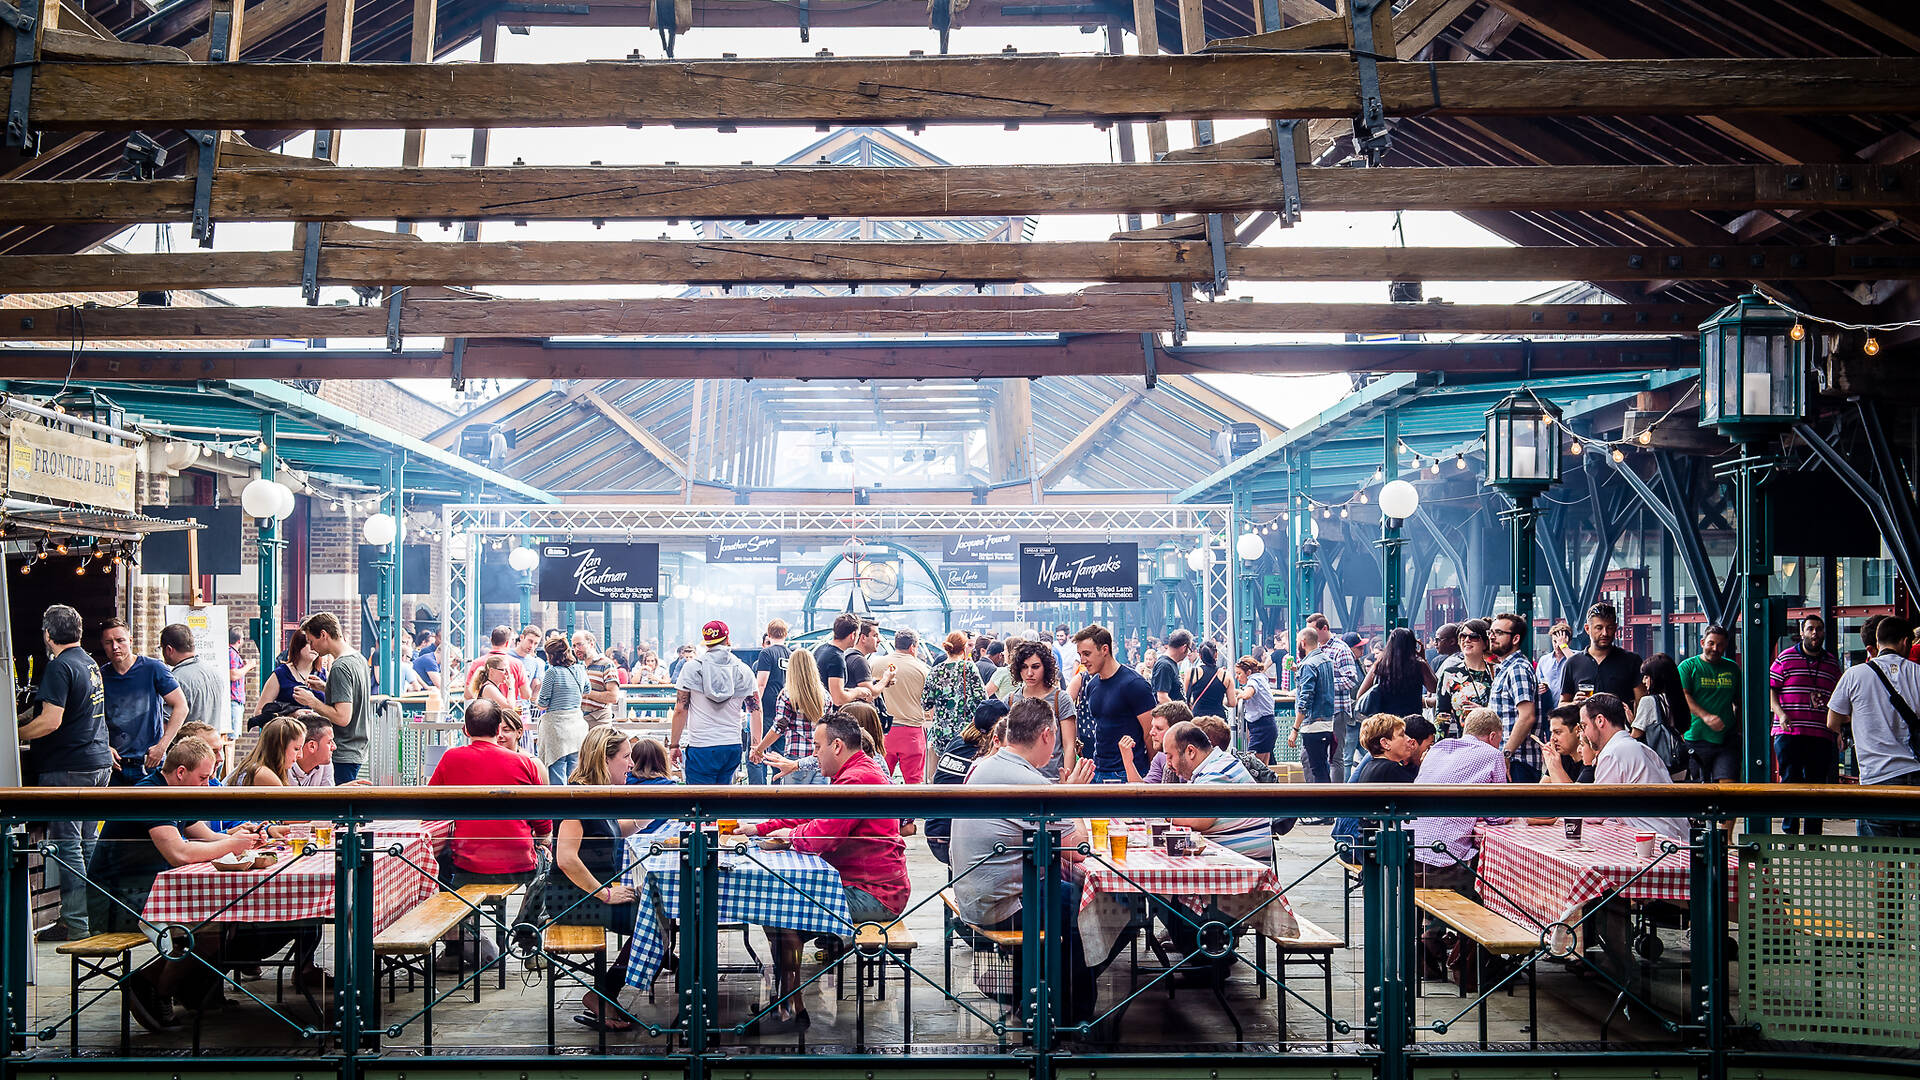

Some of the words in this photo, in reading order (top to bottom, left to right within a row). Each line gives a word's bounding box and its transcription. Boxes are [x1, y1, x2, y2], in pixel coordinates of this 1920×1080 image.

[34, 448, 91, 482] FRONTIER
[95, 462, 115, 487] BAR
[949, 534, 985, 556] Jacques
[571, 548, 602, 578] Zan
[1037, 554, 1073, 589] Maria
[1071, 554, 1121, 586] Tampakis
[574, 565, 628, 597] Kaufman
[631, 592, 654, 600] Burger
[1095, 586, 1115, 594] Spiced
